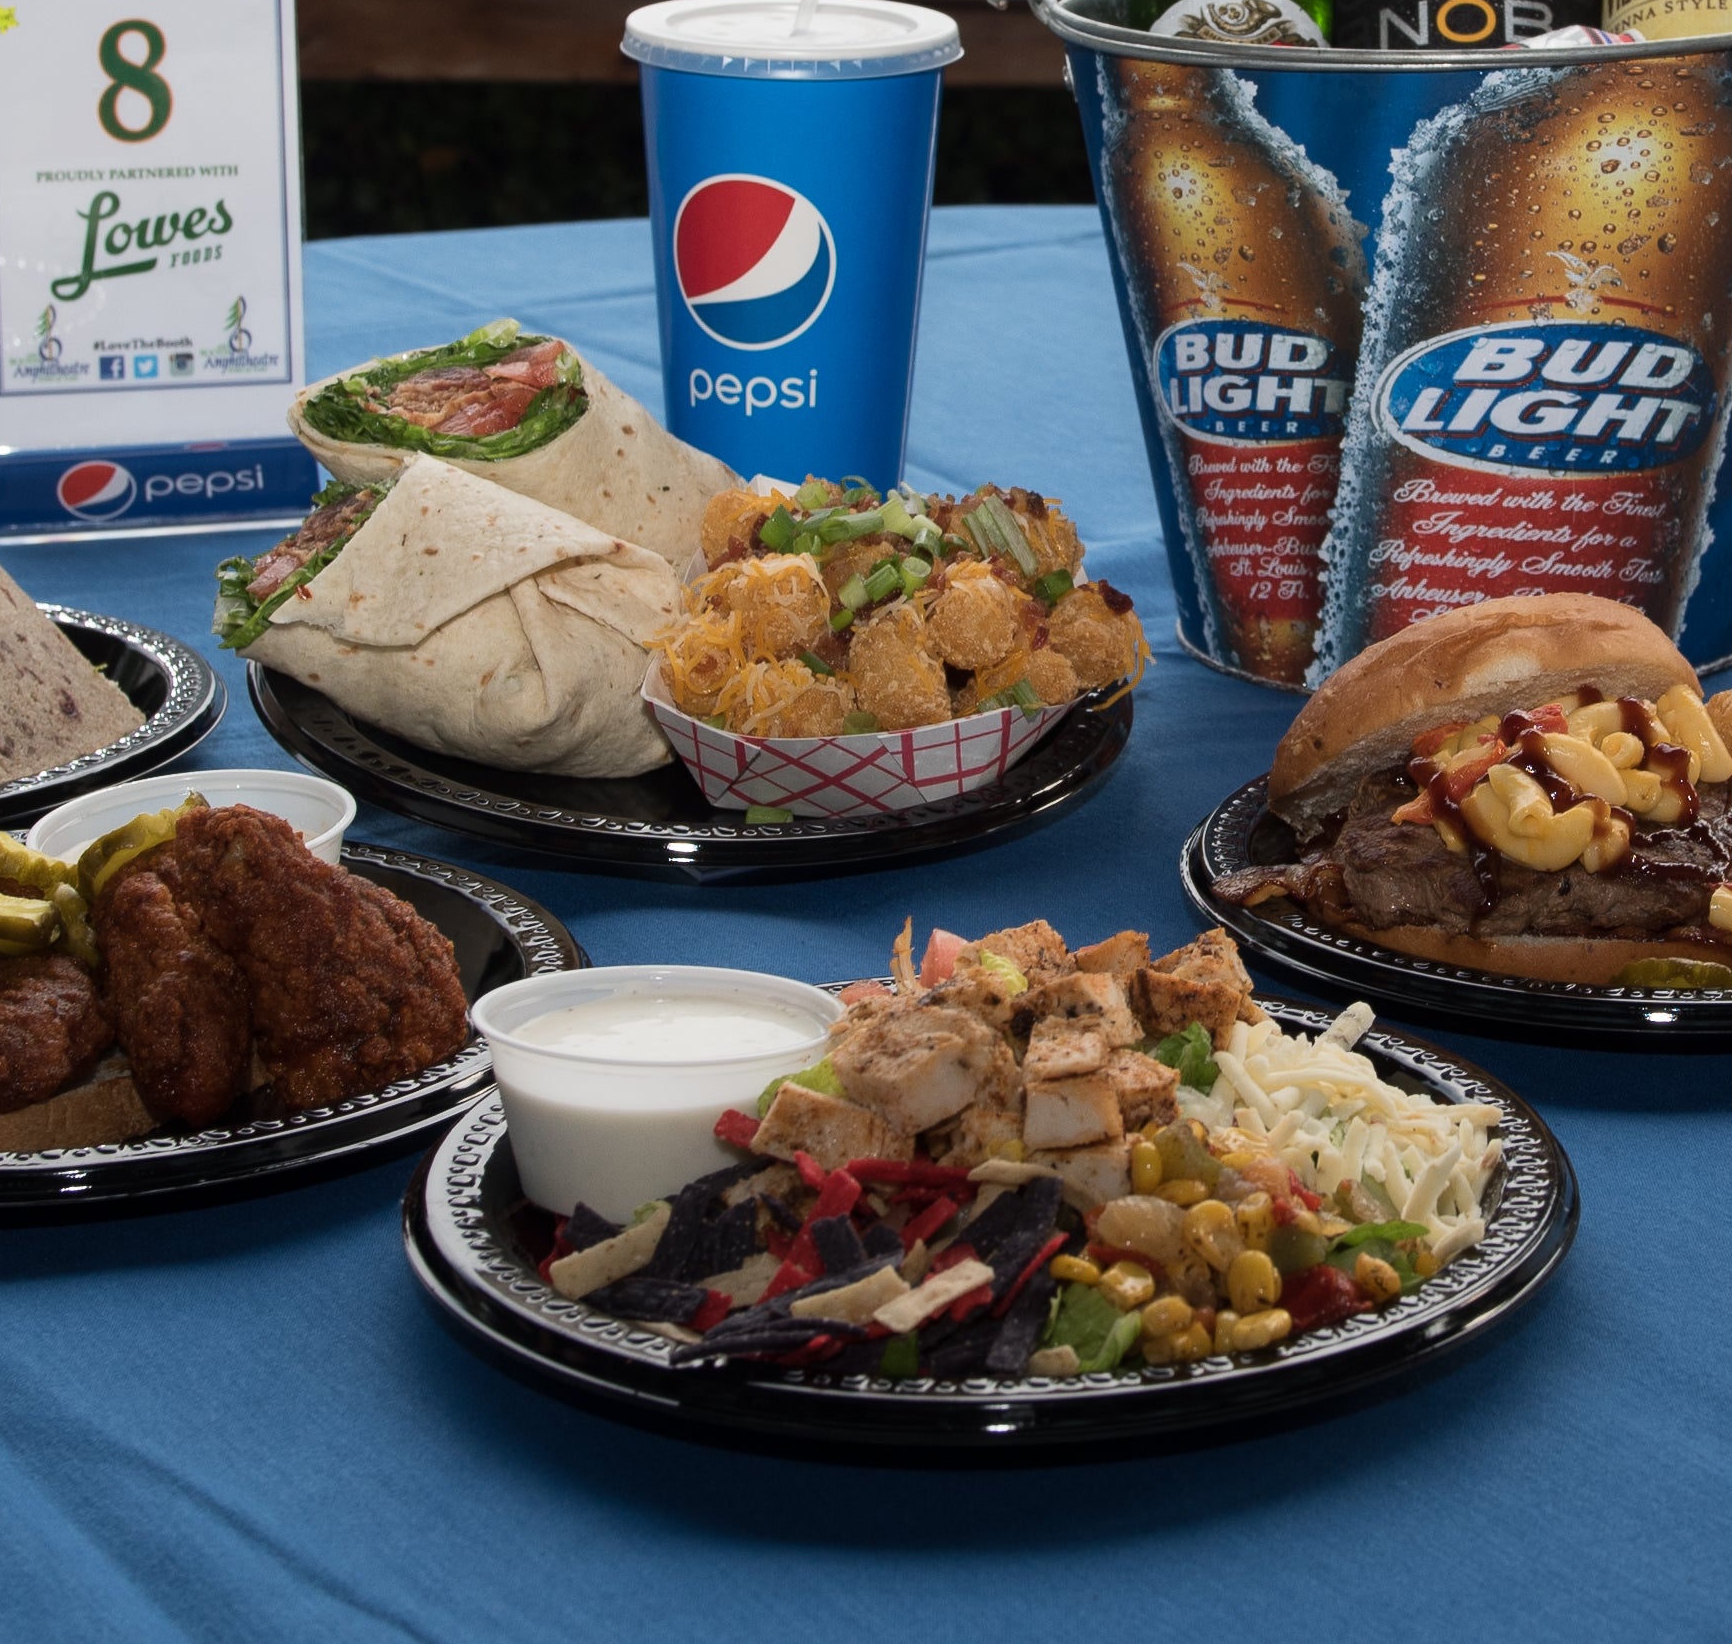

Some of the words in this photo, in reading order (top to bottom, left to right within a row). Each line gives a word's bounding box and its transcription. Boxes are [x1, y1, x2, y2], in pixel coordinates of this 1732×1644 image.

[97, 18, 173, 143] 8
[35, 169, 106, 183] PROUDLY
[109, 167, 196, 181] PARTNERED
[199, 164, 240, 178] WITH
[50, 190, 233, 301] Lowes
[170, 245, 224, 268] FOODS
[1175, 333, 1329, 371] BUD
[1453, 337, 1695, 389] BUD
[689, 368, 819, 416] pepsi
[1169, 374, 1352, 415] LIGHT
[1215, 420, 1299, 433] BEER
[1400, 387, 1702, 444] LIGHT
[1188, 454, 1237, 476] Brewed
[1240, 456, 1273, 475] with
[1276, 457, 1304, 474] the
[1487, 443, 1619, 464] BEER
[145, 464, 266, 503] pepsi
[1204, 478, 1300, 505] Ingredients
[1299, 483, 1333, 506] for
[1393, 479, 1504, 507] Brewed
[1502, 490, 1557, 510] with
[1560, 492, 1599, 513] the
[1601, 491, 1666, 518] Finest
[1412, 511, 1578, 544] Ingredients
[1571, 526, 1618, 552] for
[1619, 535, 1638, 548] a
[1230, 558, 1254, 576] St.
[1368, 539, 1518, 579] Refreshingly
[1518, 551, 1616, 579] Smooth
[1249, 581, 1273, 599] 12
